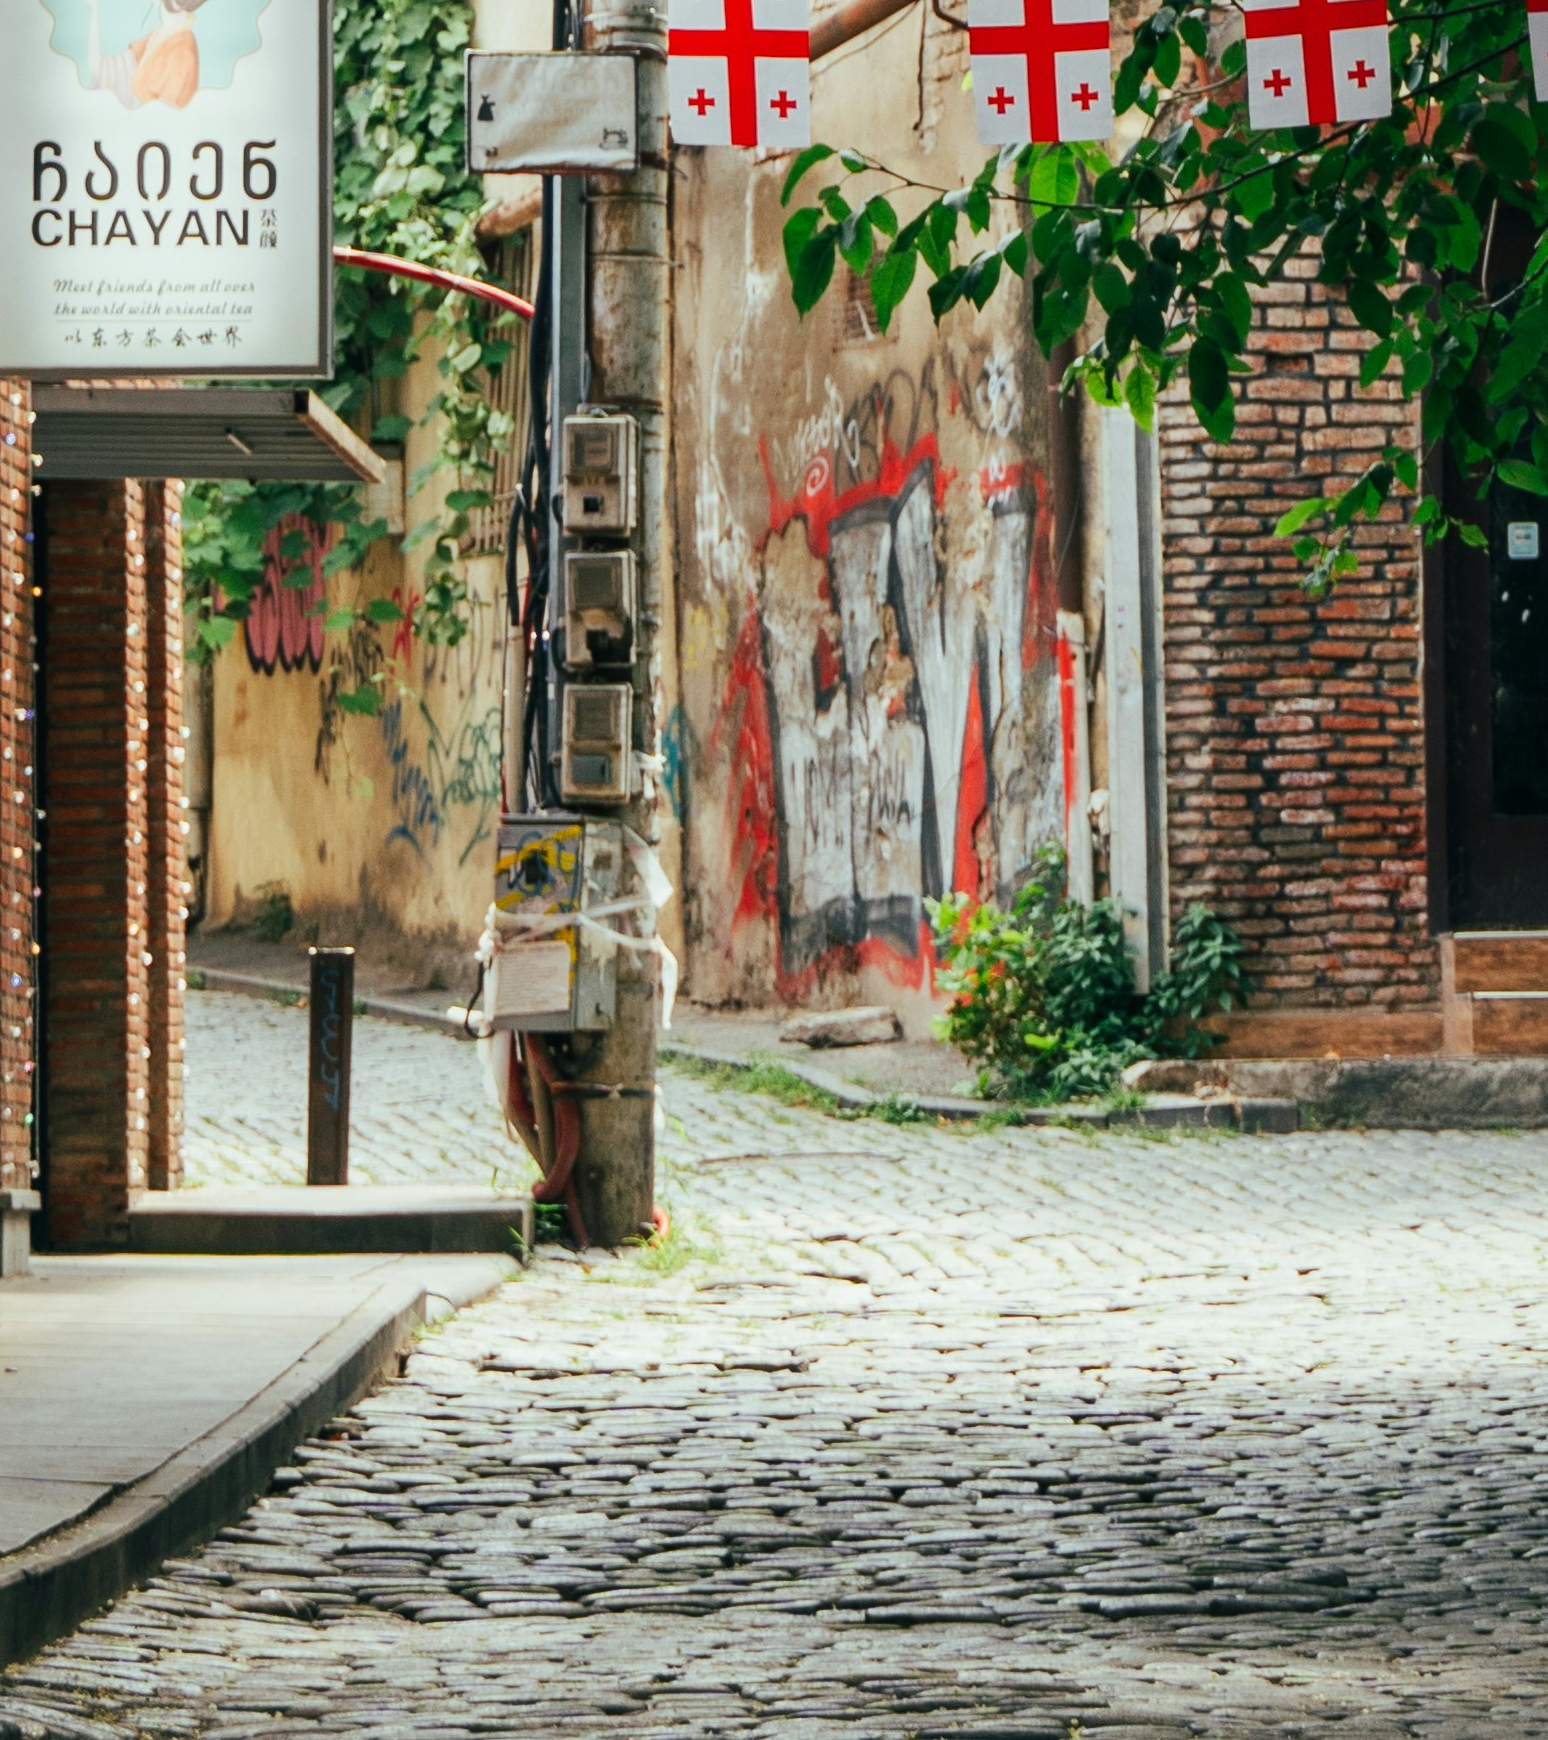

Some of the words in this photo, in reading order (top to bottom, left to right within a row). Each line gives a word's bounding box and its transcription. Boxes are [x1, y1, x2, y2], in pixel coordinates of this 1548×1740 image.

[32, 139, 278, 202] ჩაიენ
[31, 209, 250, 248] CHAYAN
[53, 279, 93, 294] Meet
[95, 279, 154, 297] friends
[156, 279, 196, 297] from
[199, 278, 221, 294] all
[223, 281, 256, 293] over
[54, 302, 77, 316] the
[80, 301, 125, 316] world
[128, 301, 161, 316] with
[164, 301, 228, 316] oriental
[229, 302, 253, 316] tea
